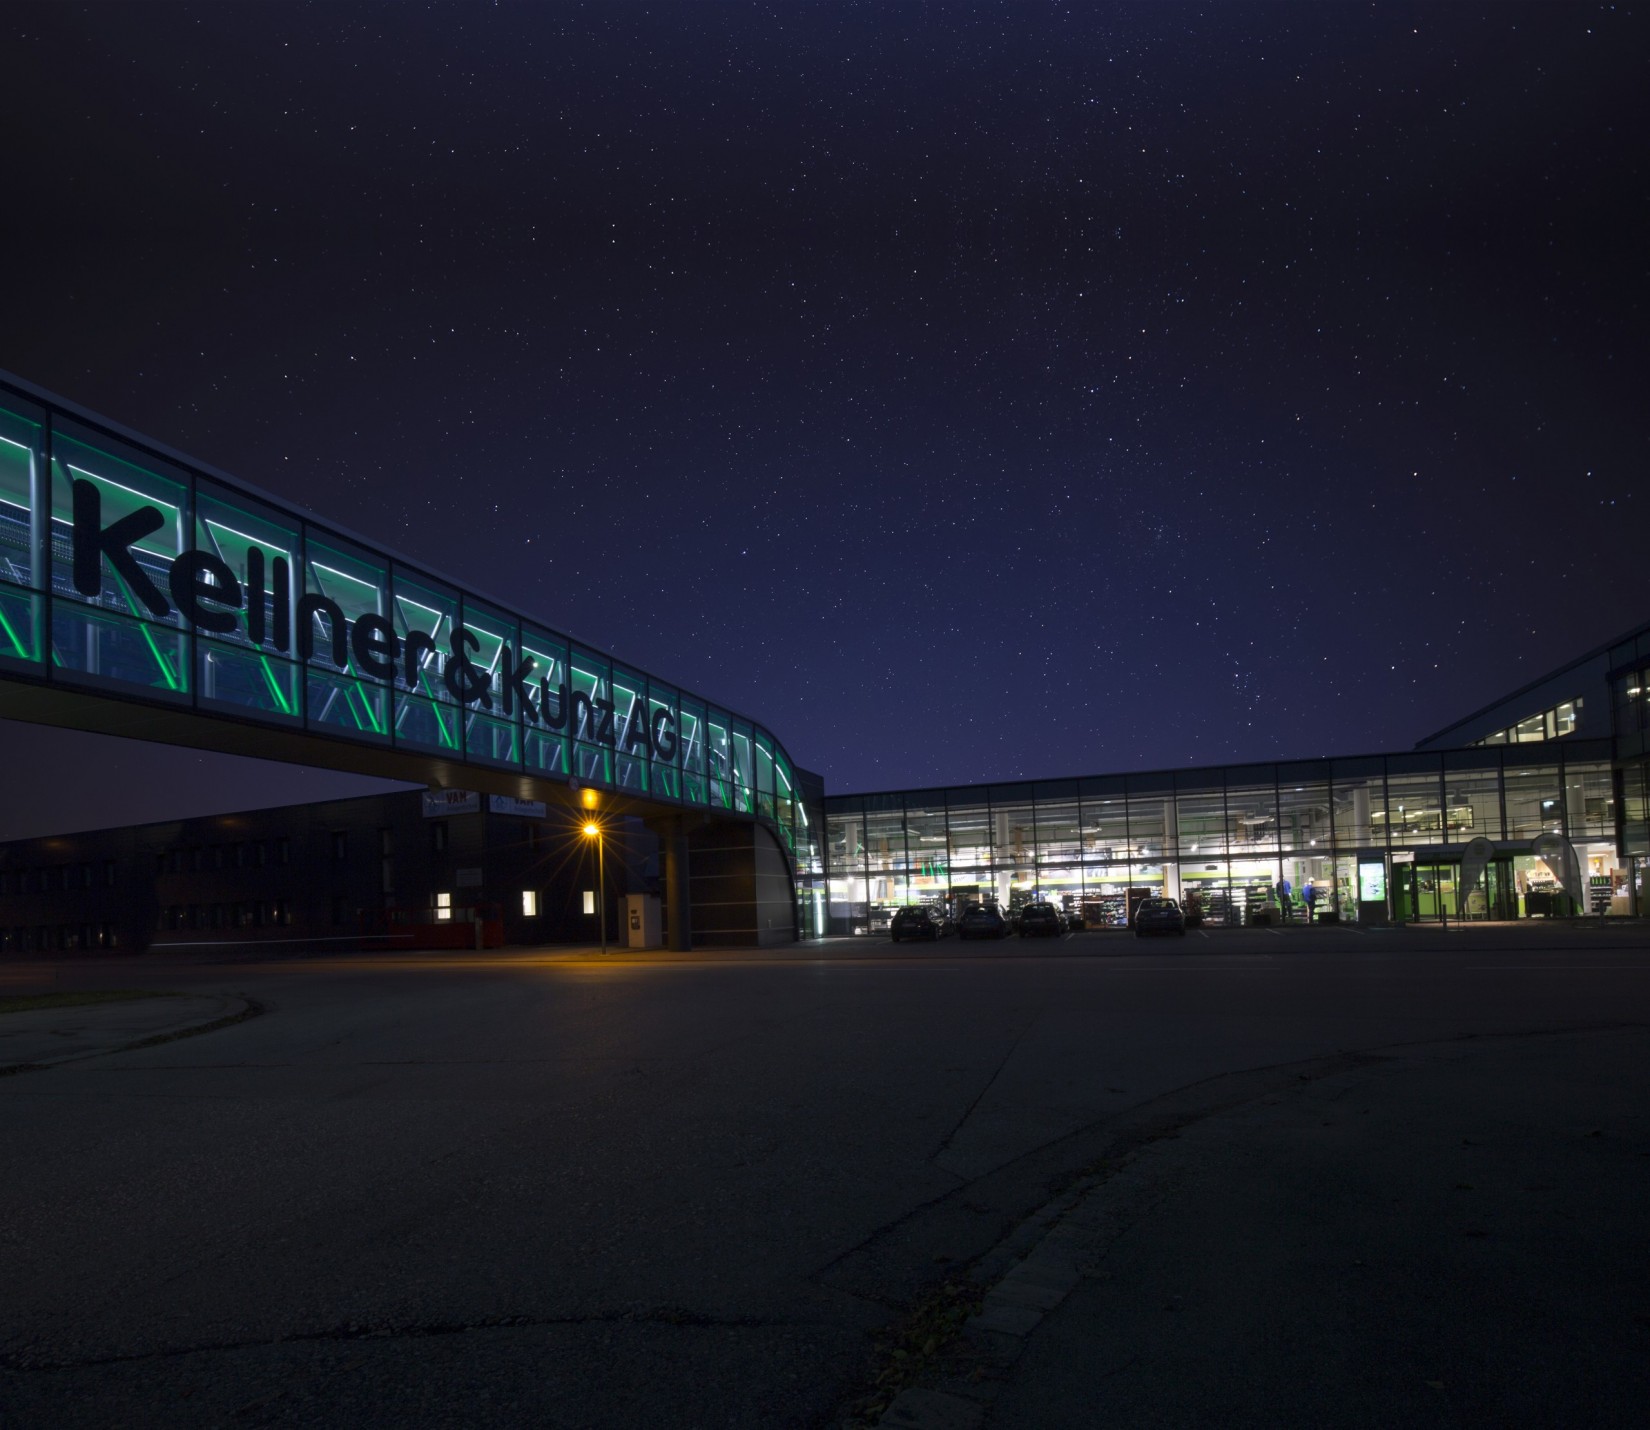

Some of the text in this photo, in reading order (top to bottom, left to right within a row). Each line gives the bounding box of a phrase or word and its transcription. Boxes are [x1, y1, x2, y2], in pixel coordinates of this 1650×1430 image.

[73, 479, 676, 762] Kellner & Kunz AG
[446, 791, 467, 805] VAM
